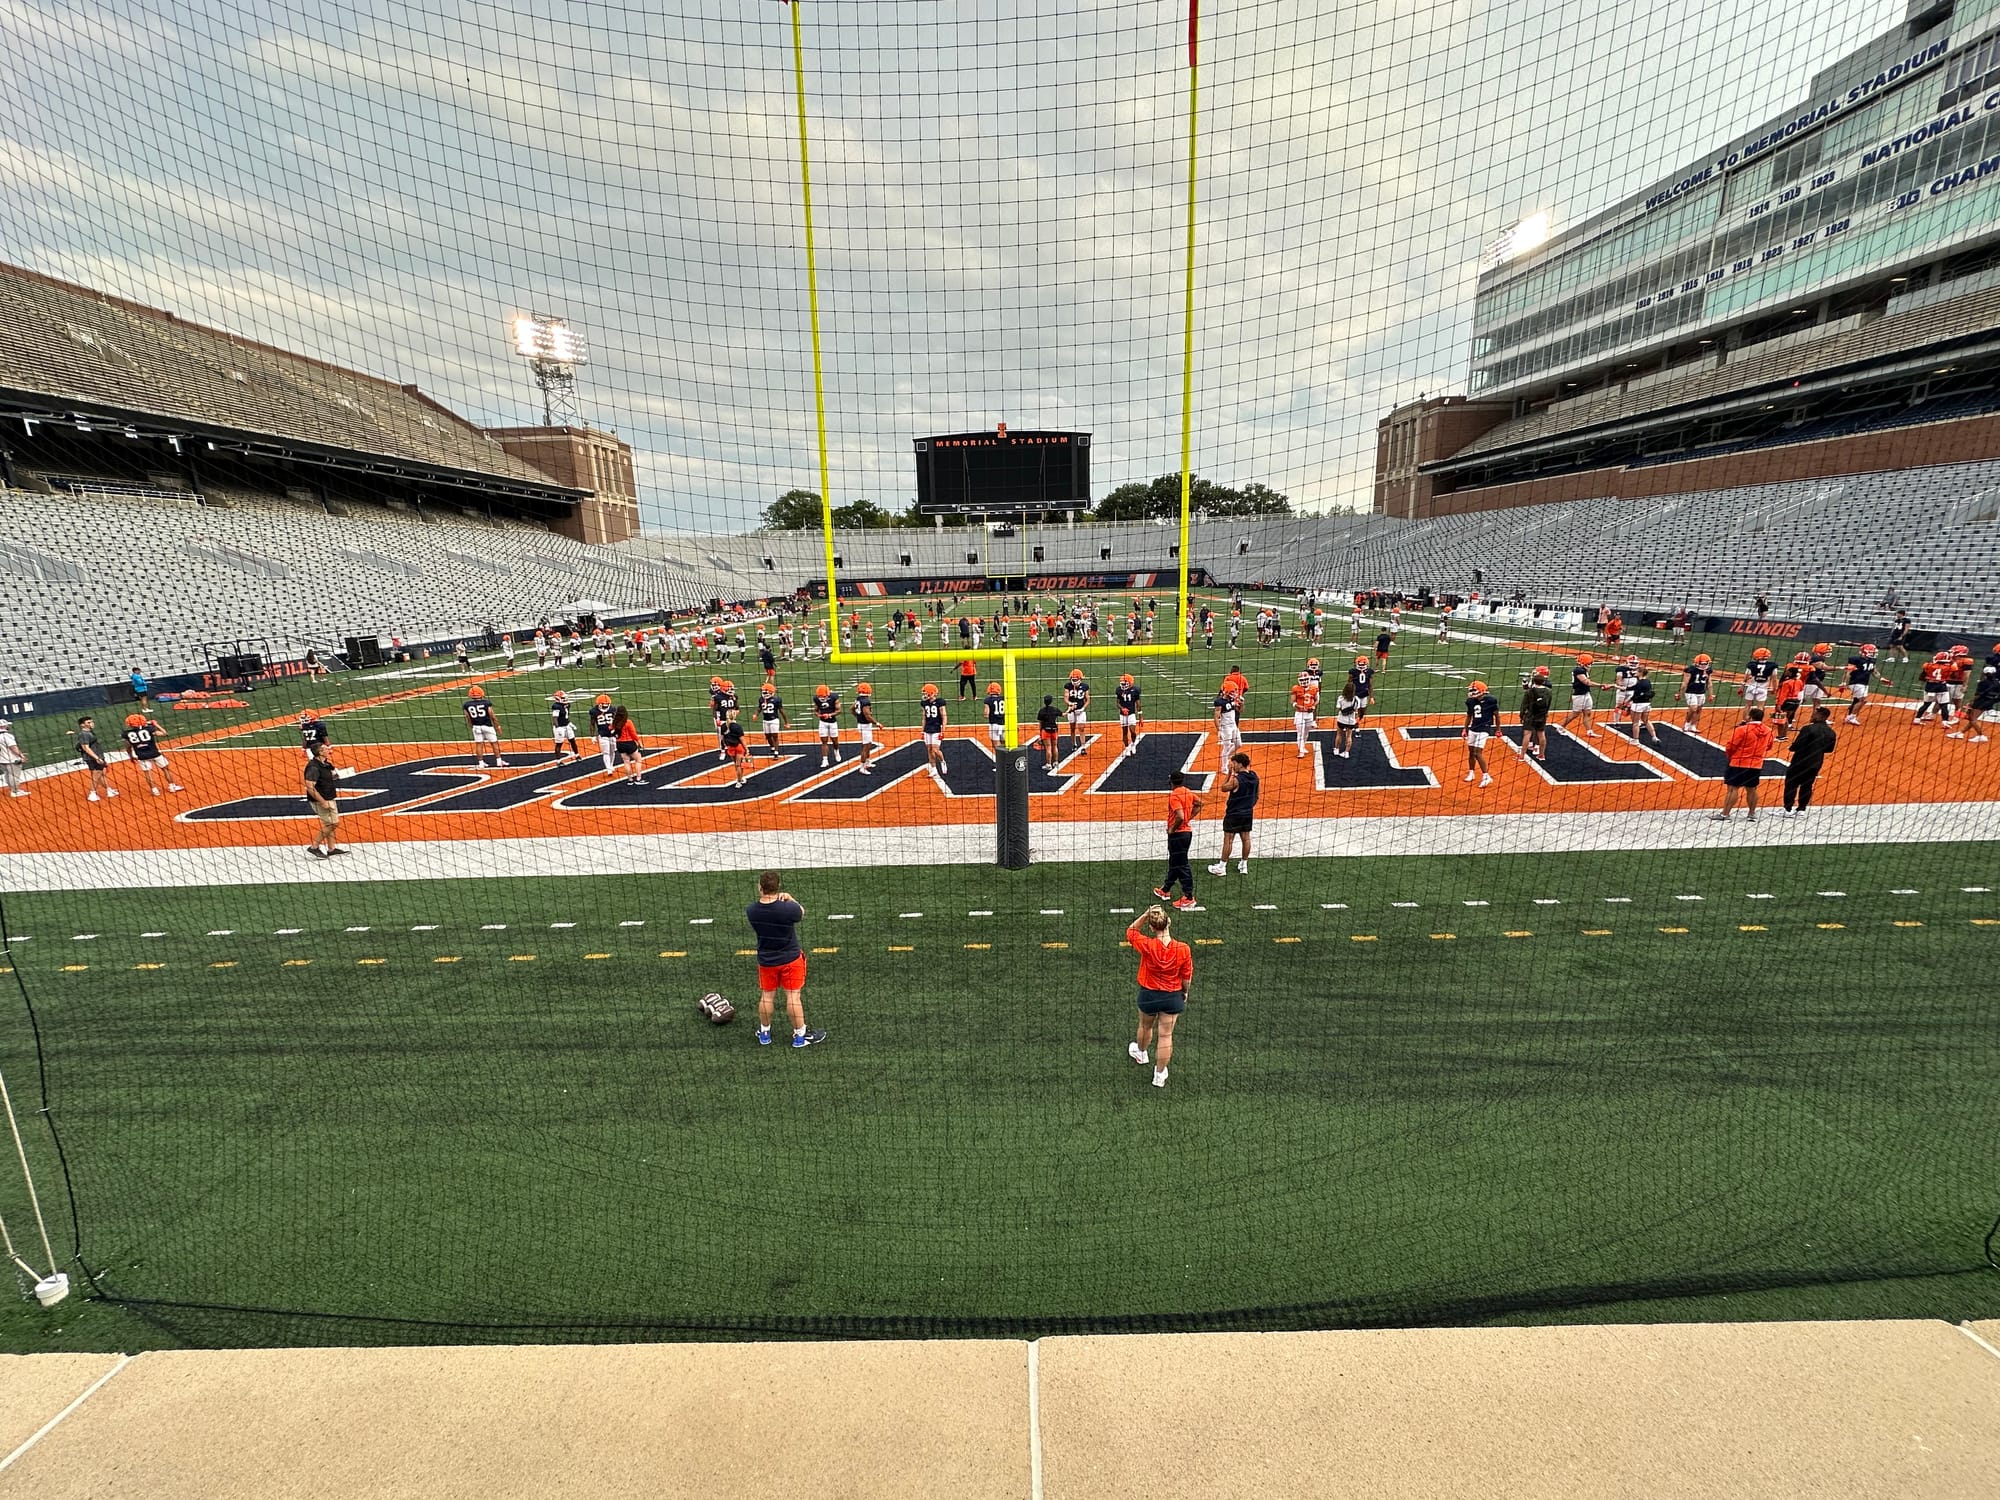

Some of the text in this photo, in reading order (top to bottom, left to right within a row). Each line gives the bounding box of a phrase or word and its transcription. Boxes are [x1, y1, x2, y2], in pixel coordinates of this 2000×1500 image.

[1645, 37, 1950, 210] WELCOME TO MEMORIAL STADIUM
[1861, 106, 1975, 168] NATIONAL
[1791, 232, 1815, 250] 1927
[936, 436, 1068, 447] MEMORIAL STADIUM
[919, 580, 985, 593] ILLINOIS
[1729, 619, 1803, 638] ILLINOIS
[1932, 668, 1942, 680] 4
[467, 704, 486, 718] 85
[924, 705, 938, 718] 39
[1473, 705, 1482, 718] 2
[597, 712, 613, 725] 25
[127, 729, 151, 744] 80
